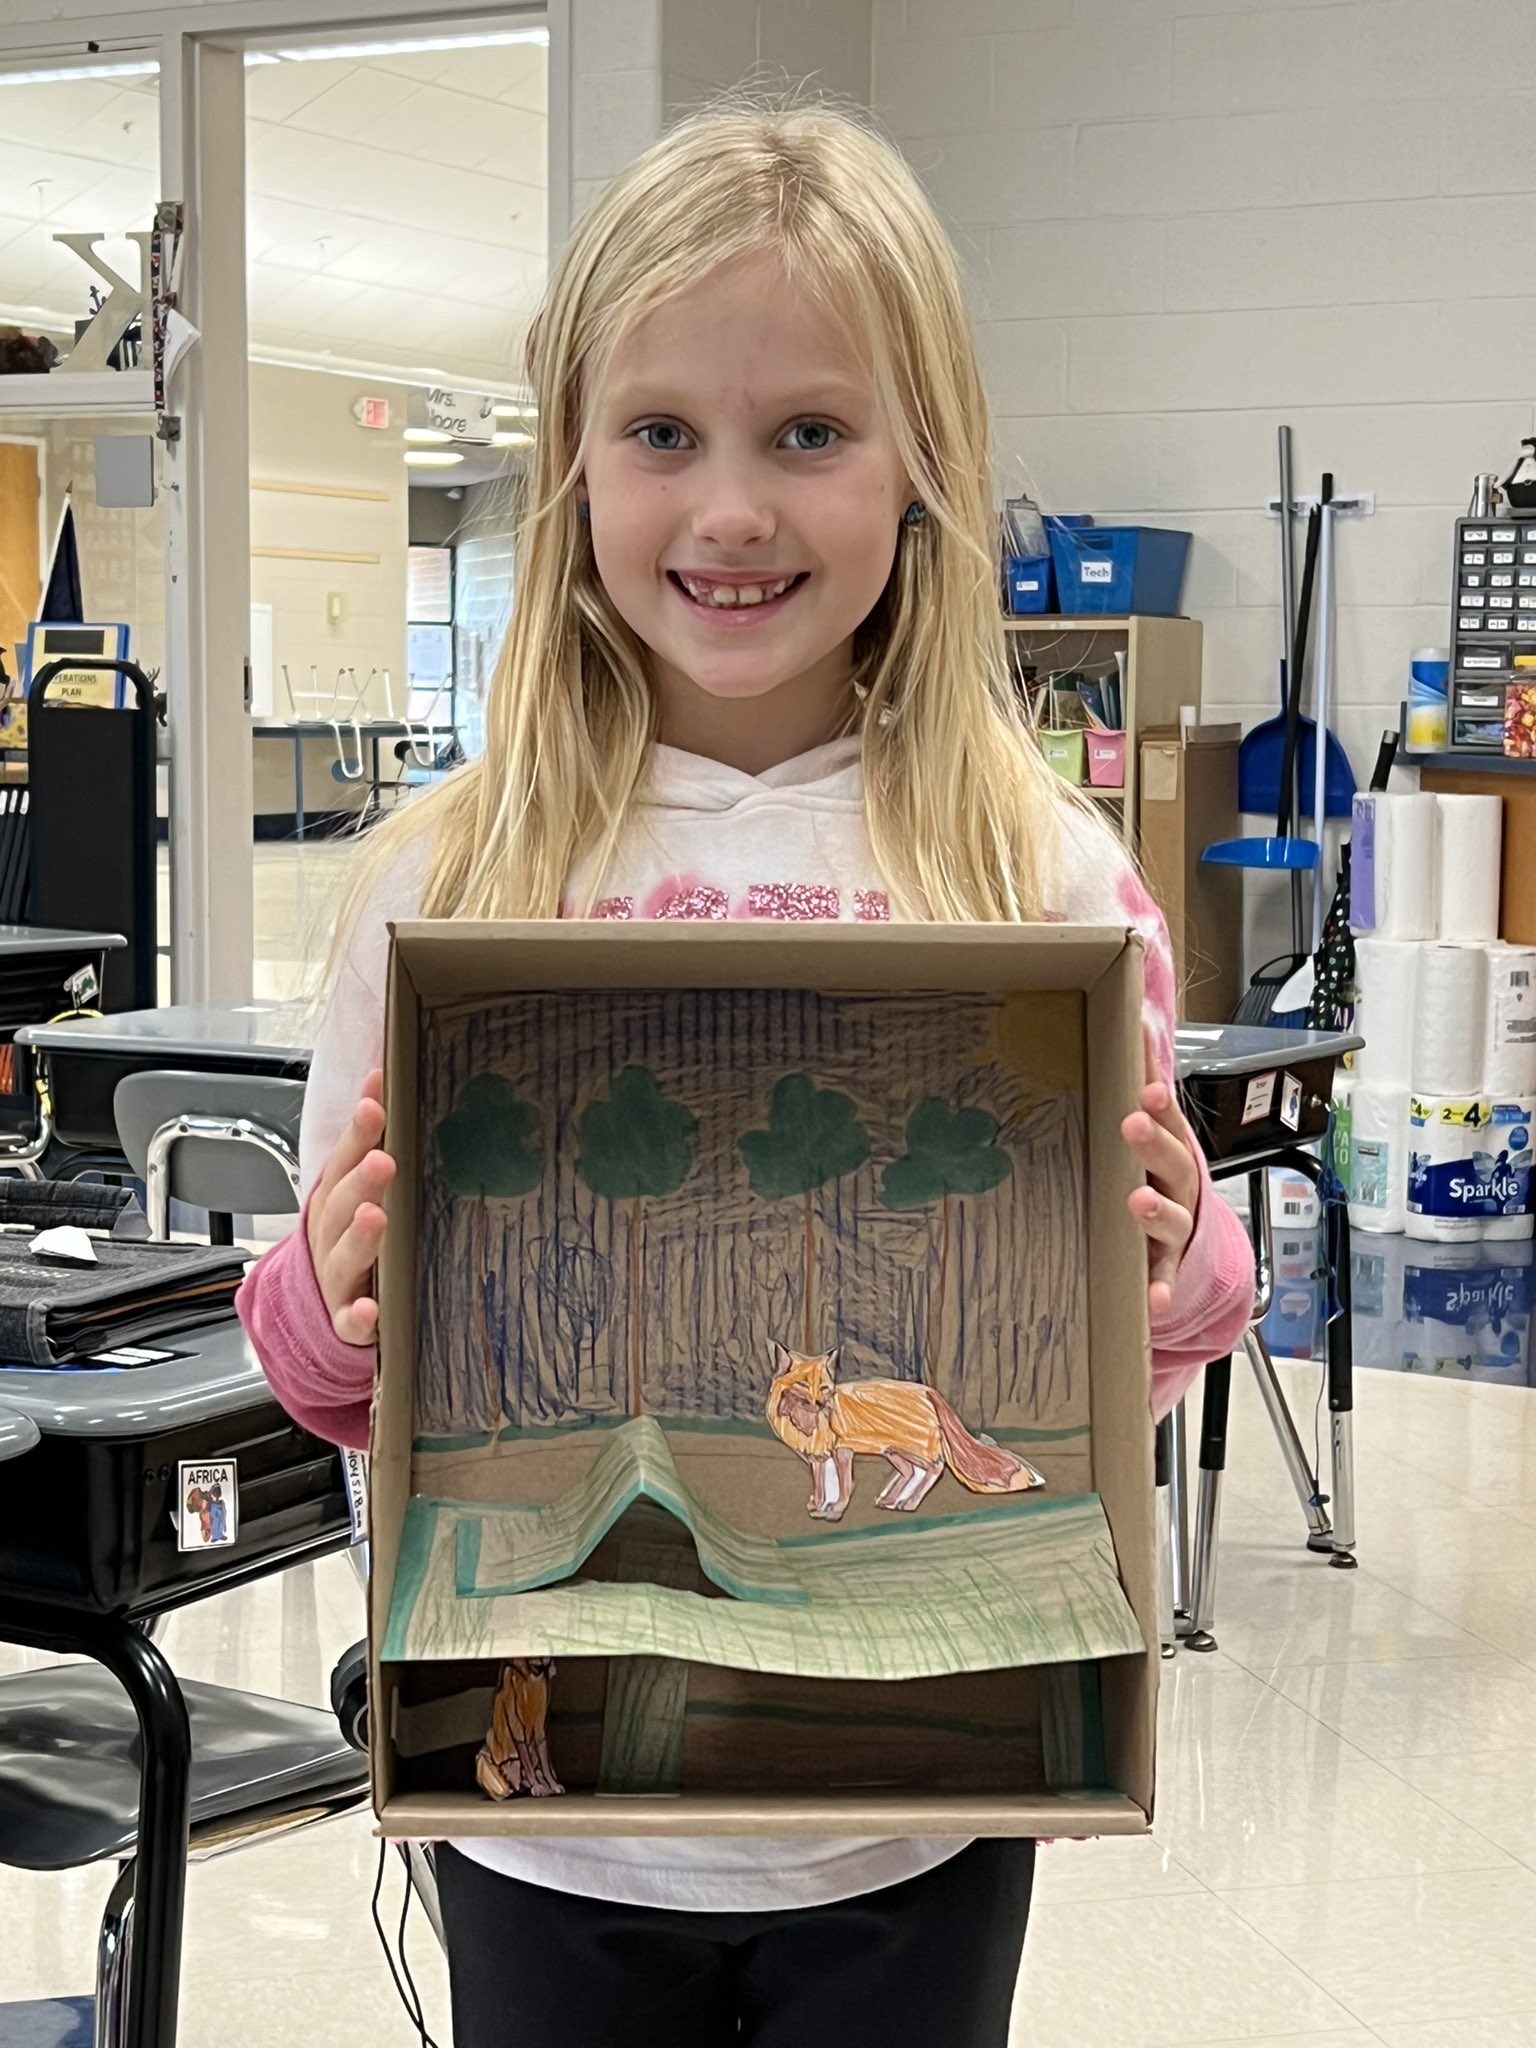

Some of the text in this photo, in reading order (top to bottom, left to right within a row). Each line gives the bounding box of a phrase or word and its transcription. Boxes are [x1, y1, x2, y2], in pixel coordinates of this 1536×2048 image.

[431, 409, 467, 433] oore
[61, 687, 82, 697] PLAN
[1442, 1107, 1453, 1120] 2
[1463, 1102, 1482, 1128] 4
[1449, 1176, 1519, 1203] Sparkle
[188, 1468, 228, 1485] AFRICA
